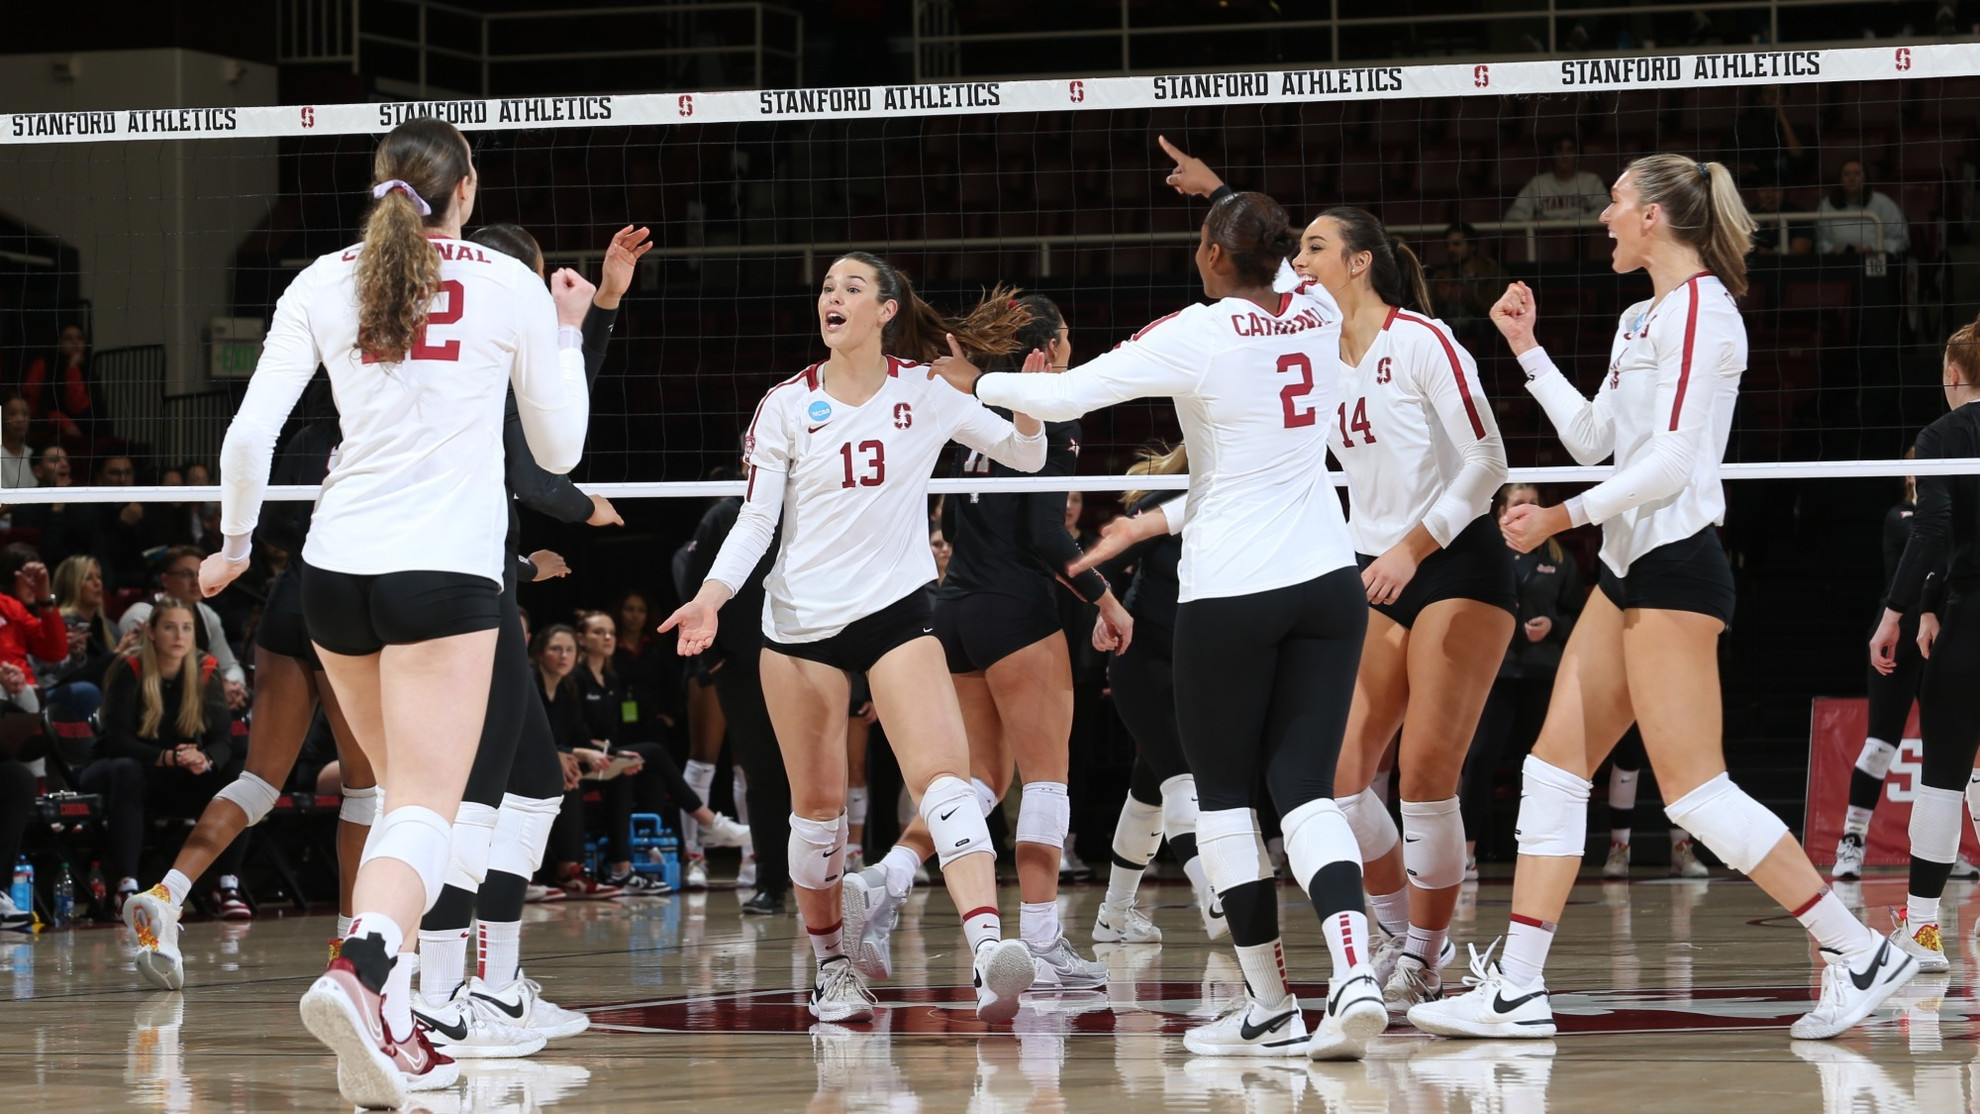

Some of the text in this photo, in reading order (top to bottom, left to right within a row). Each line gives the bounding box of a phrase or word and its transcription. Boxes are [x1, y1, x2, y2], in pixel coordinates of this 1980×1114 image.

[1153, 67, 1402, 100] STANFORD ATHLETICS
[1562, 51, 1821, 85] STANFORD ATHLETICS
[379, 97, 612, 126] STANFORD ATHLETICS
[760, 82, 1000, 114] STANFORD ATHLETICS
[12, 108, 237, 137] STANFORD ATHLETICS
[341, 242, 492, 264] CNAL
[1276, 352, 1316, 429] 2
[1337, 396, 1377, 448] 14
[840, 439, 885, 489] 13
